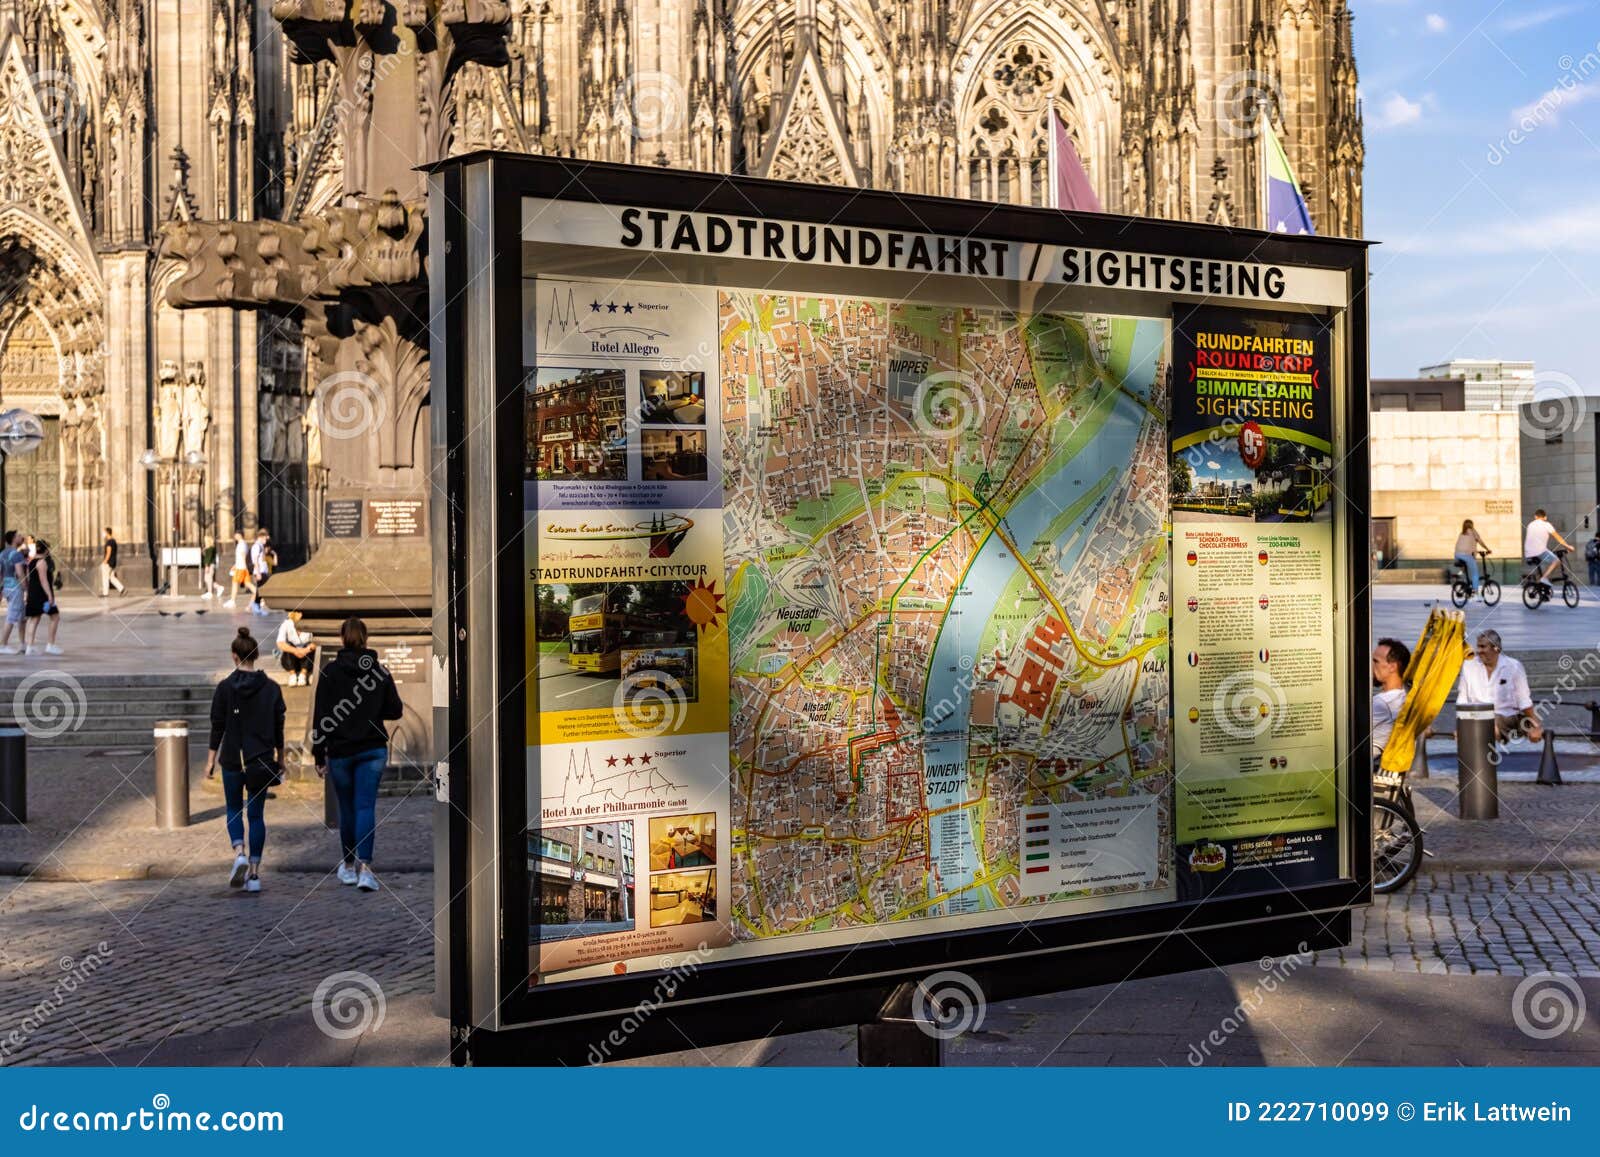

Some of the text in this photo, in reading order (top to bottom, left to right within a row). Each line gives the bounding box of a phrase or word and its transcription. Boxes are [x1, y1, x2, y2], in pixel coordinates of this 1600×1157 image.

[620, 207, 1008, 278] STADTRUNDFAHRT
[1062, 248, 1286, 300] SIGHTSEEING
[638, 302, 669, 312] Superior
[591, 341, 660, 356] Hotel Allegro
[1196, 332, 1314, 356] RUNDFAHRTEN
[889, 359, 929, 374] NIPPES
[1196, 380, 1313, 400] BIMMELBAHN
[1196, 397, 1314, 420] SIGHTSEEING
[605, 523, 635, 533] Service
[787, 621, 811, 633] Nord
[1142, 660, 1166, 673] KALK
[808, 713, 827, 722] Nord
[654, 749, 687, 759] Superior
[542, 799, 687, 818] Hotel An der Philharmonie GmbH
